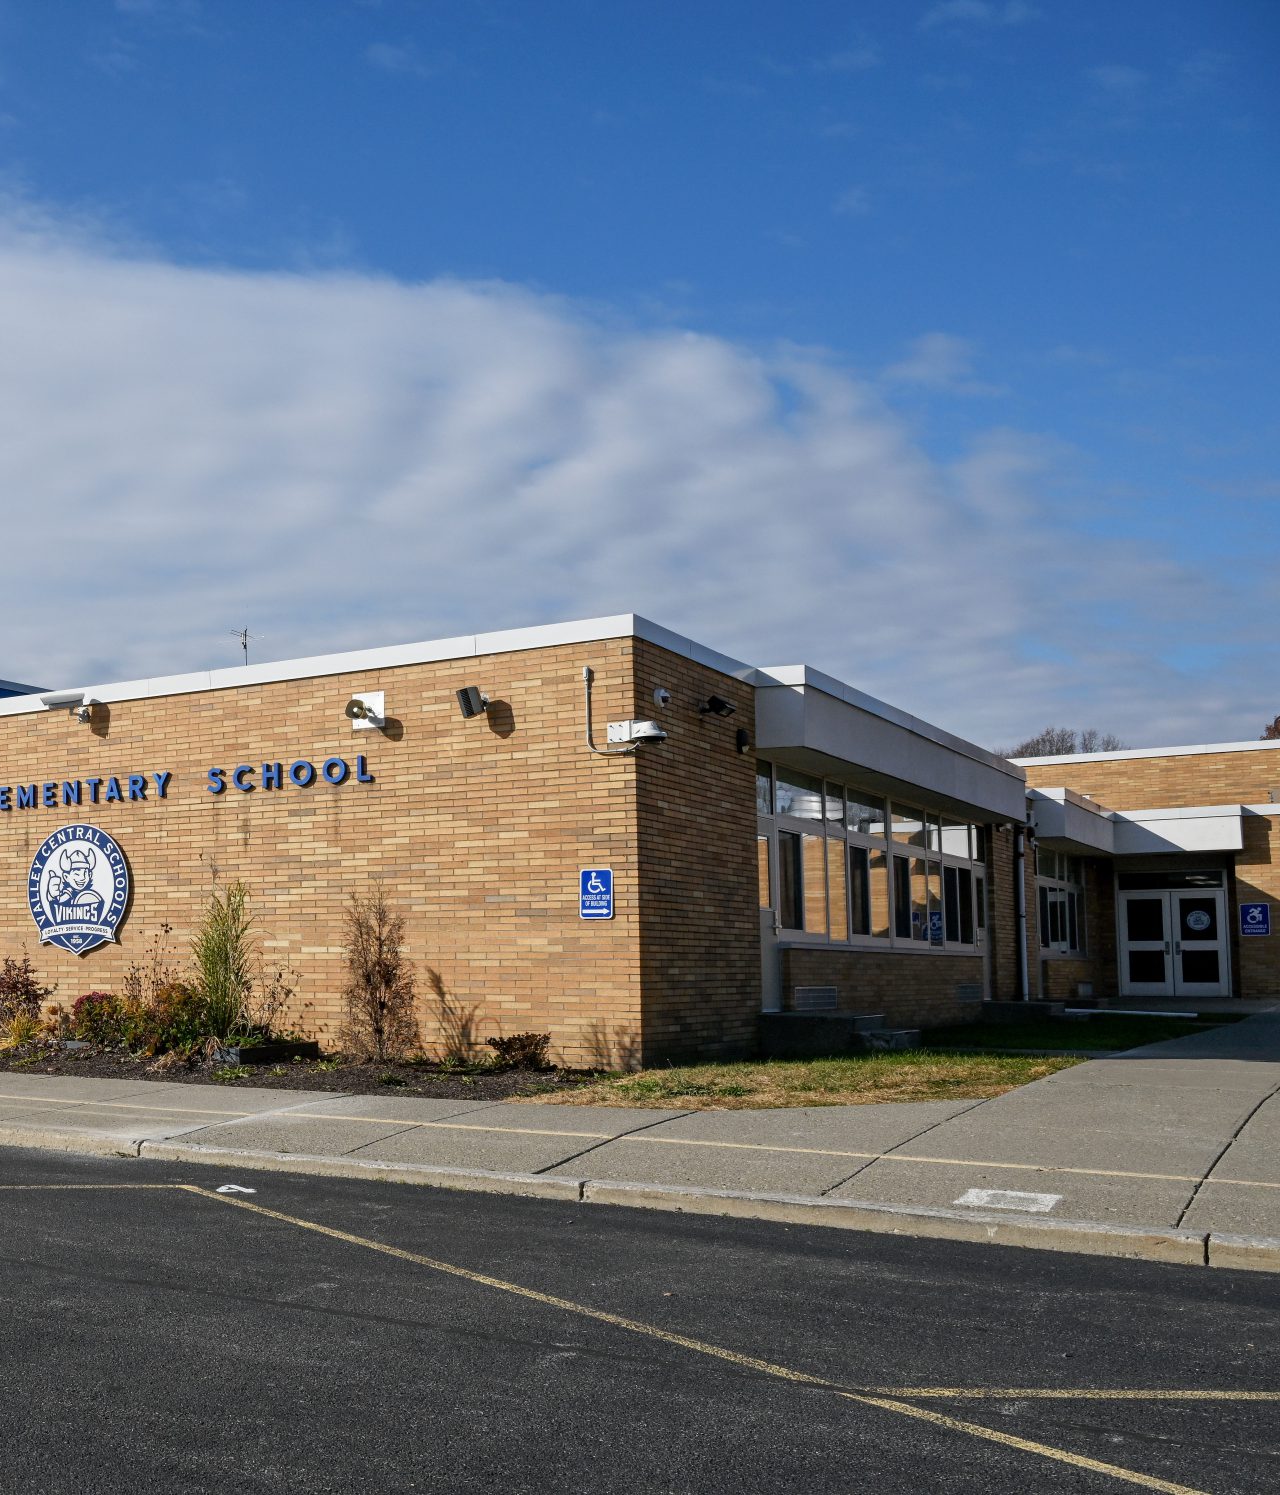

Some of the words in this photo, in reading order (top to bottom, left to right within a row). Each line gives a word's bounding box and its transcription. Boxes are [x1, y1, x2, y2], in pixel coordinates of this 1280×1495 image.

[207, 755, 375, 794] SCHOOL
[30, 860, 45, 925] VALLEY
[42, 827, 100, 856] CENTRAL
[104, 843, 125, 923] SCHOOLS
[54, 902, 99, 922] VIKINGS
